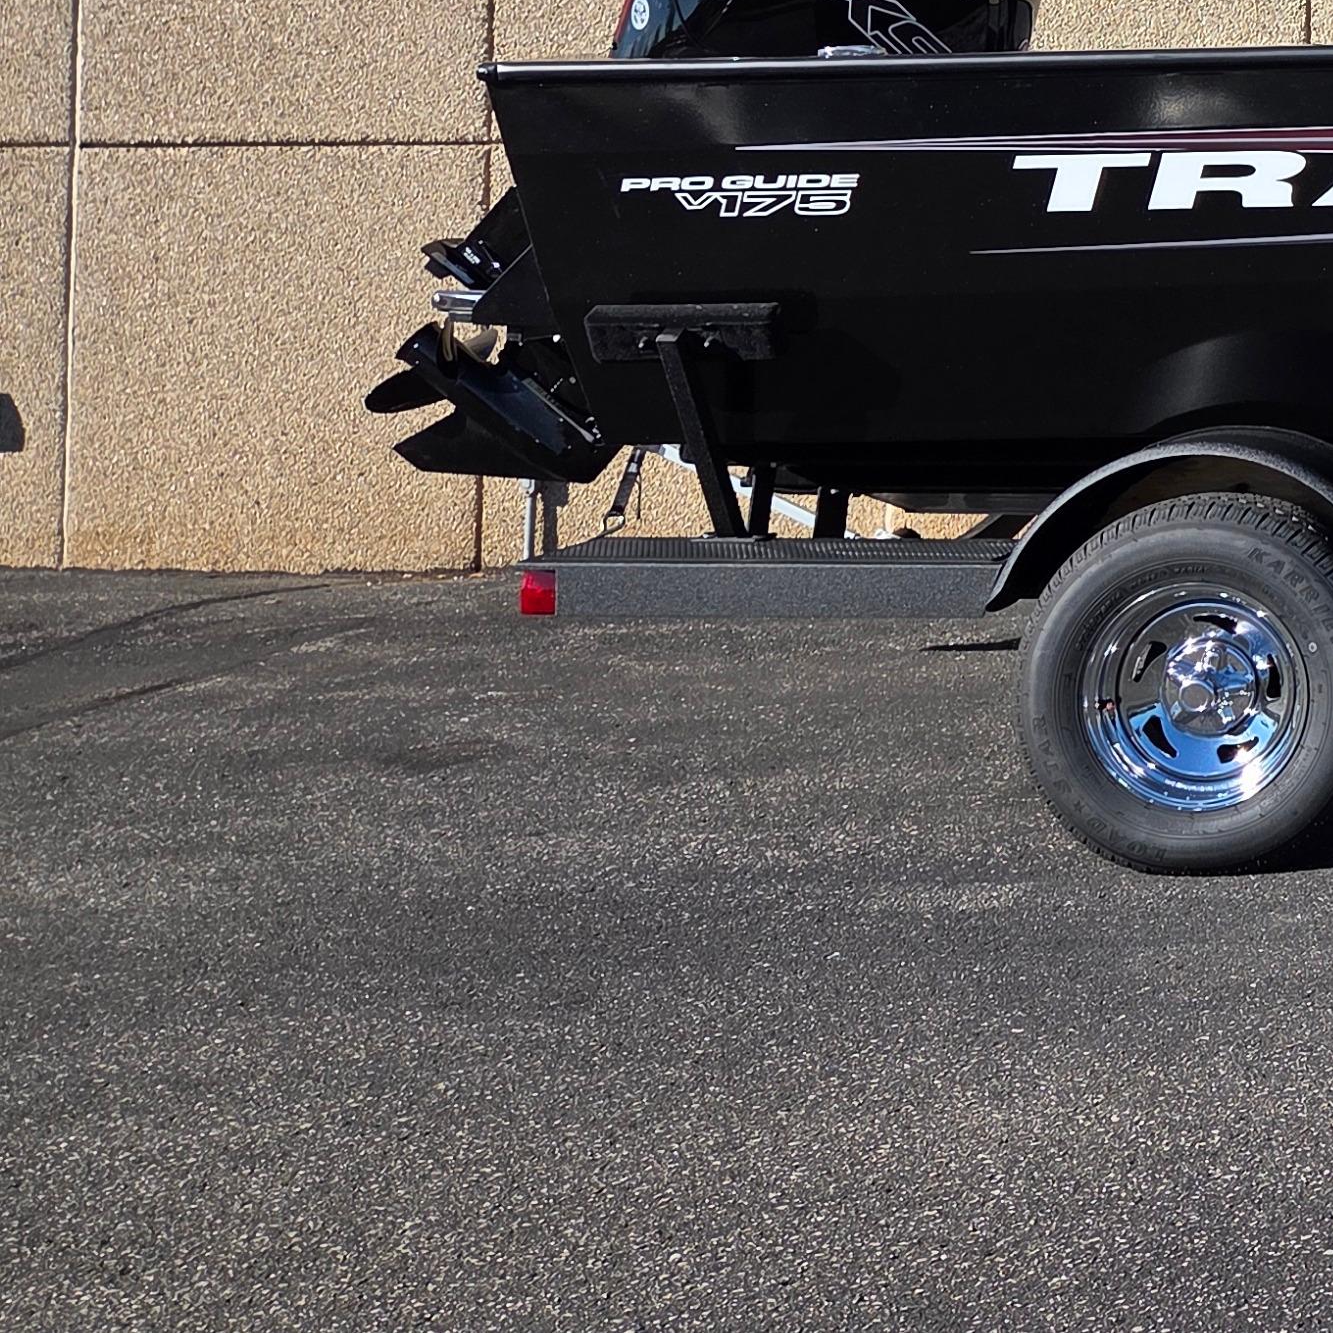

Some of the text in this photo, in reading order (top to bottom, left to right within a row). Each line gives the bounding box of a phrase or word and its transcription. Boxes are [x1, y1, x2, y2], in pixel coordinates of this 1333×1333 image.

[620, 173, 860, 193] PRO GUIDE
[674, 189, 853, 218] V175
